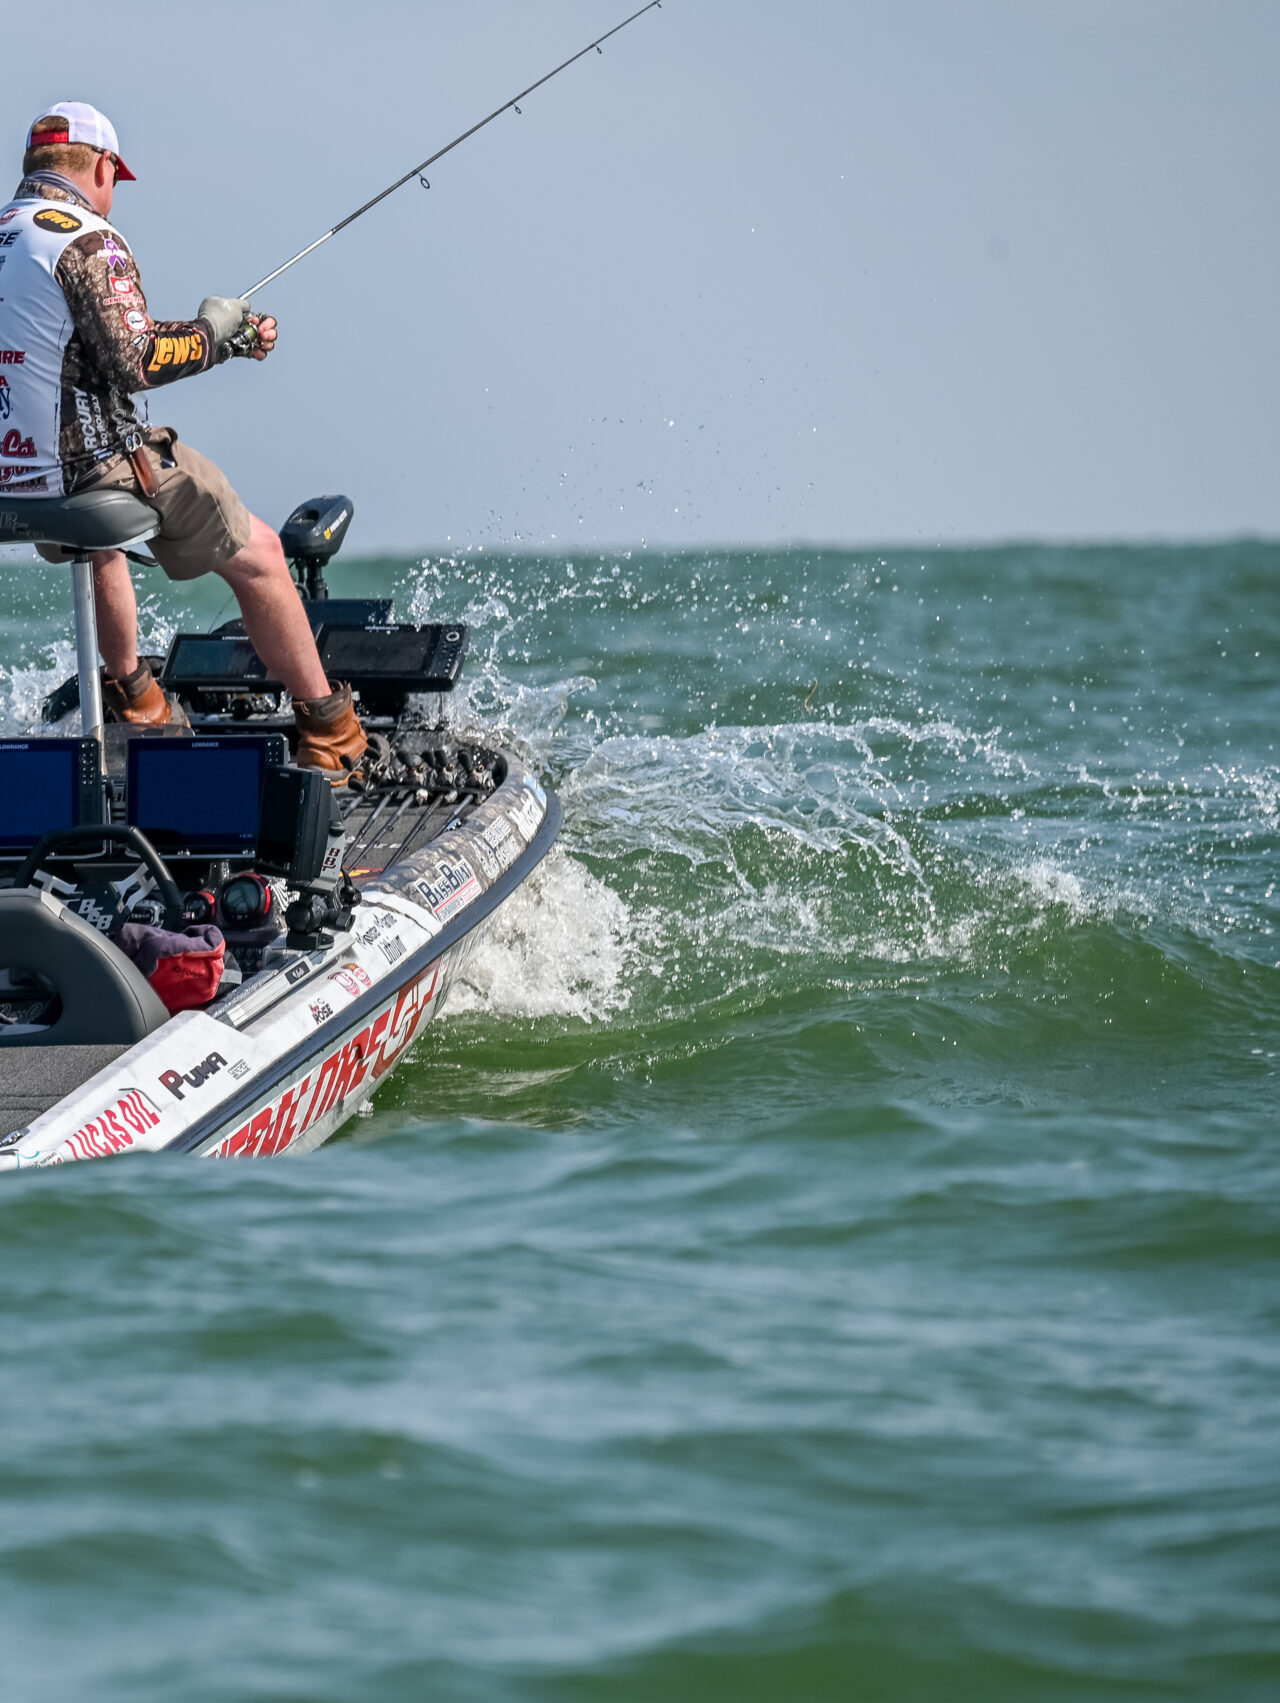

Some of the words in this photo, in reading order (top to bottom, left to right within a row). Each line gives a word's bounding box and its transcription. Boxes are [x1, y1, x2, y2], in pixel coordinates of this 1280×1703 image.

[72, 385, 98, 452] RCURY
[312, 1003, 334, 1025] ROSE
[65, 1109, 133, 1160] LUCAS
[117, 1090, 161, 1135] OIL
